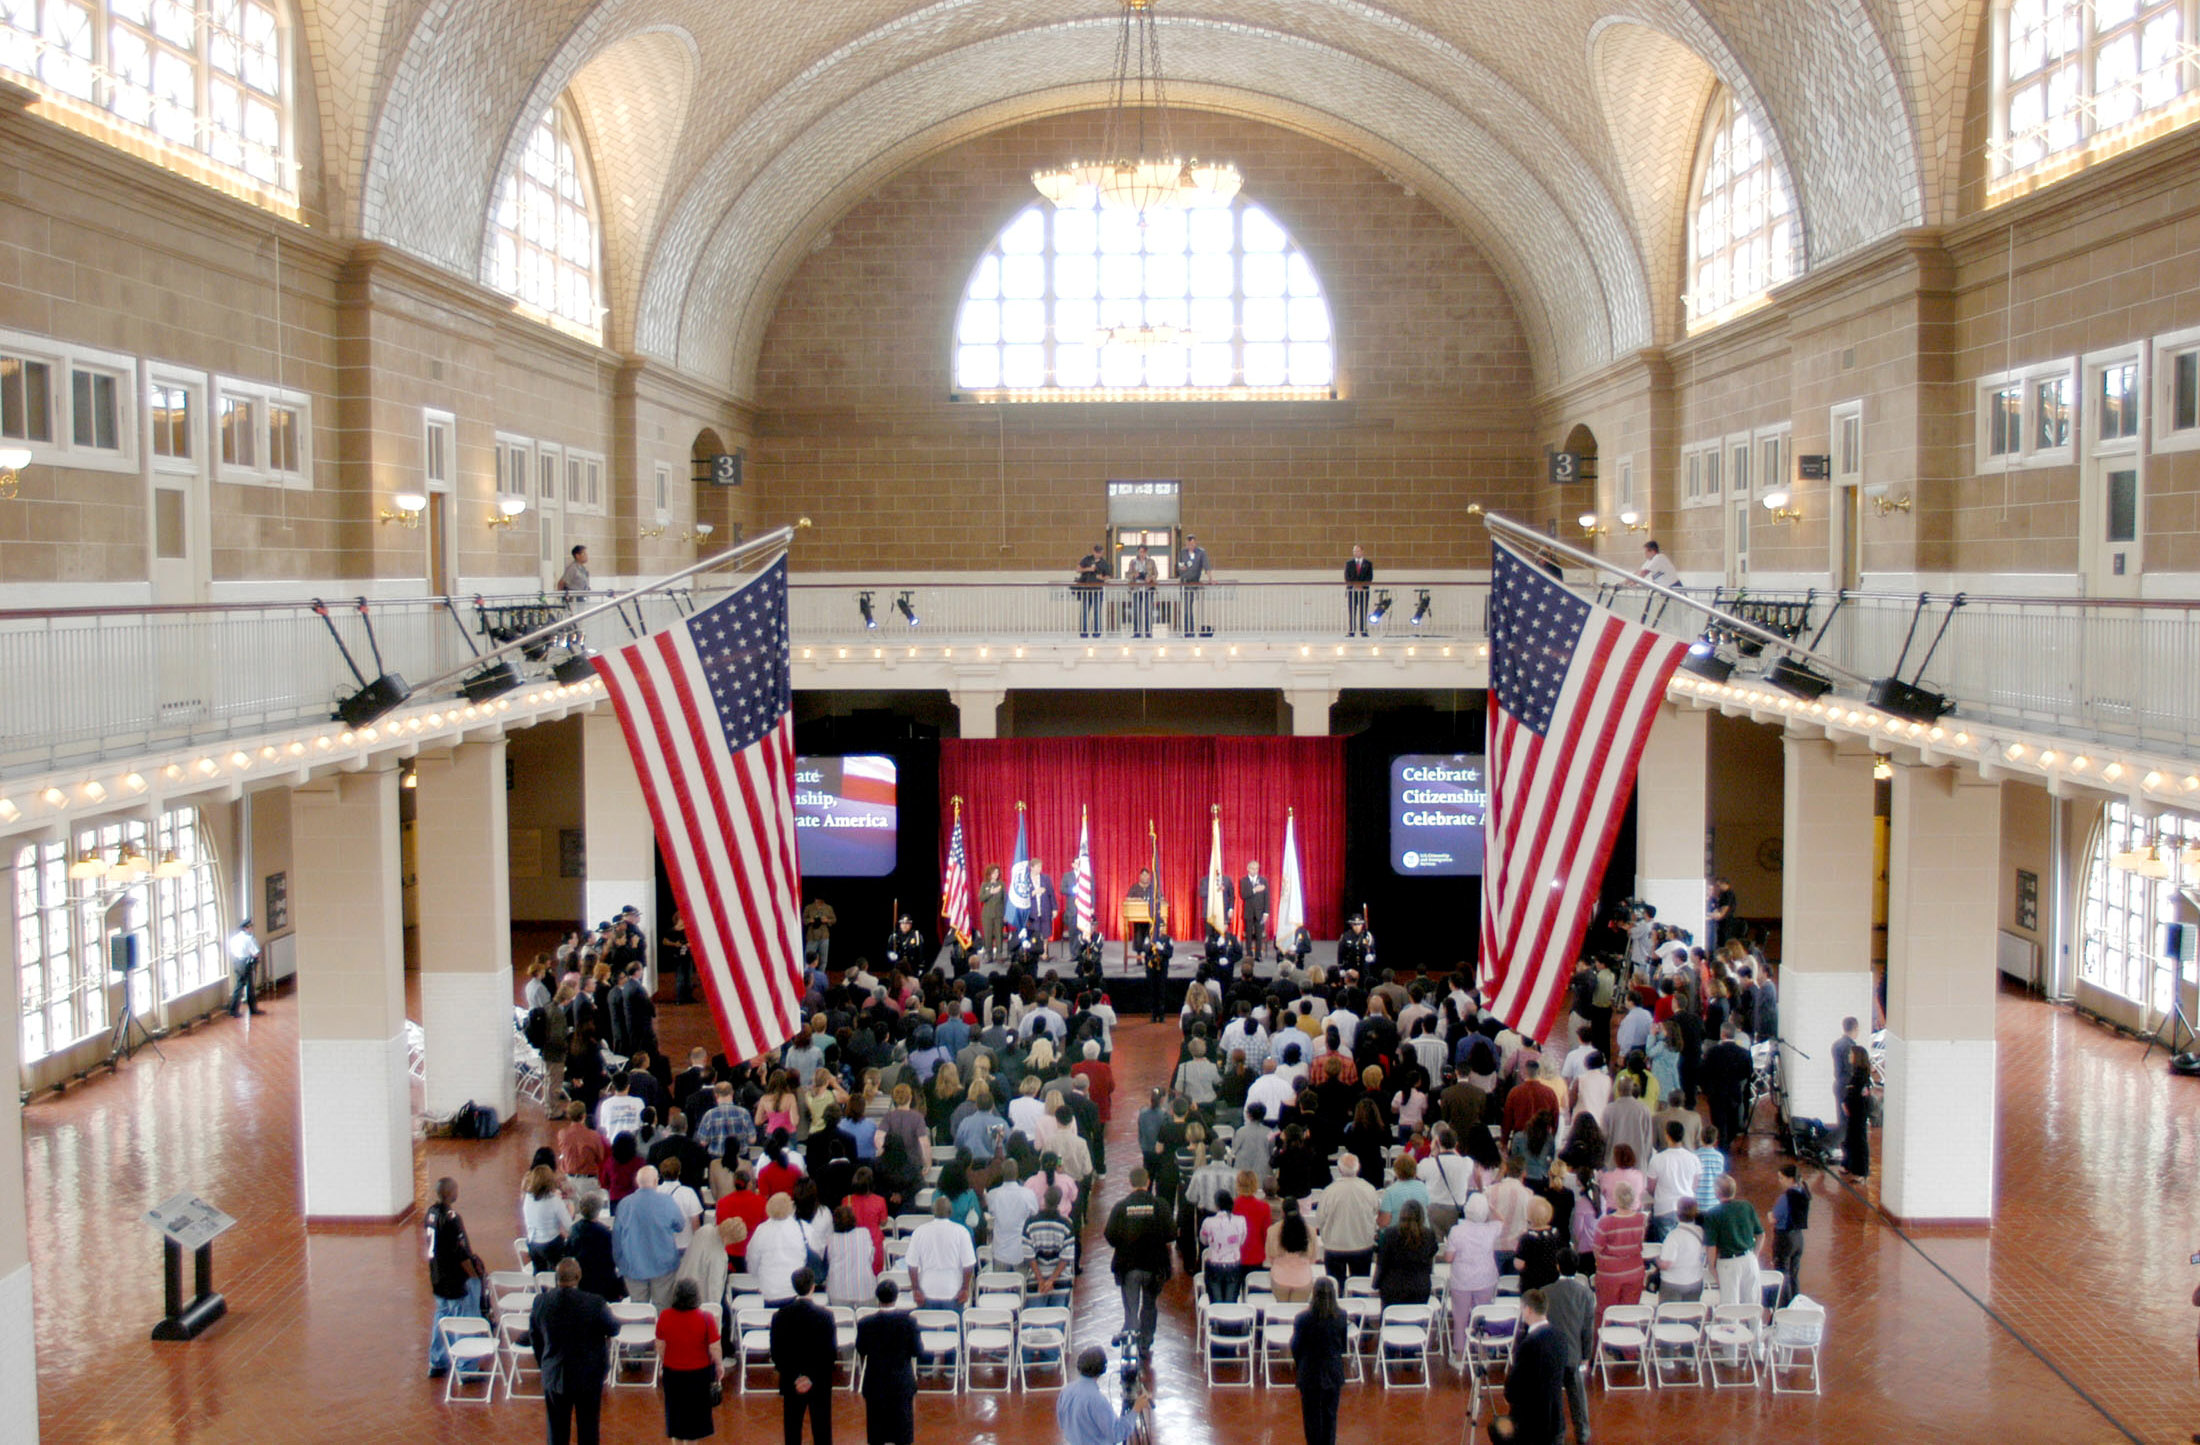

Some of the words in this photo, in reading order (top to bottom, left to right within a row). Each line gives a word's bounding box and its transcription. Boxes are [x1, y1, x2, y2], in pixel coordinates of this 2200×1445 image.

[718, 456, 734, 477] 3
[1556, 453, 1572, 475] 3
[1402, 766, 1477, 782] Celebrate
[823, 813, 888, 827] America
[1402, 811, 1476, 826] Celebrate
